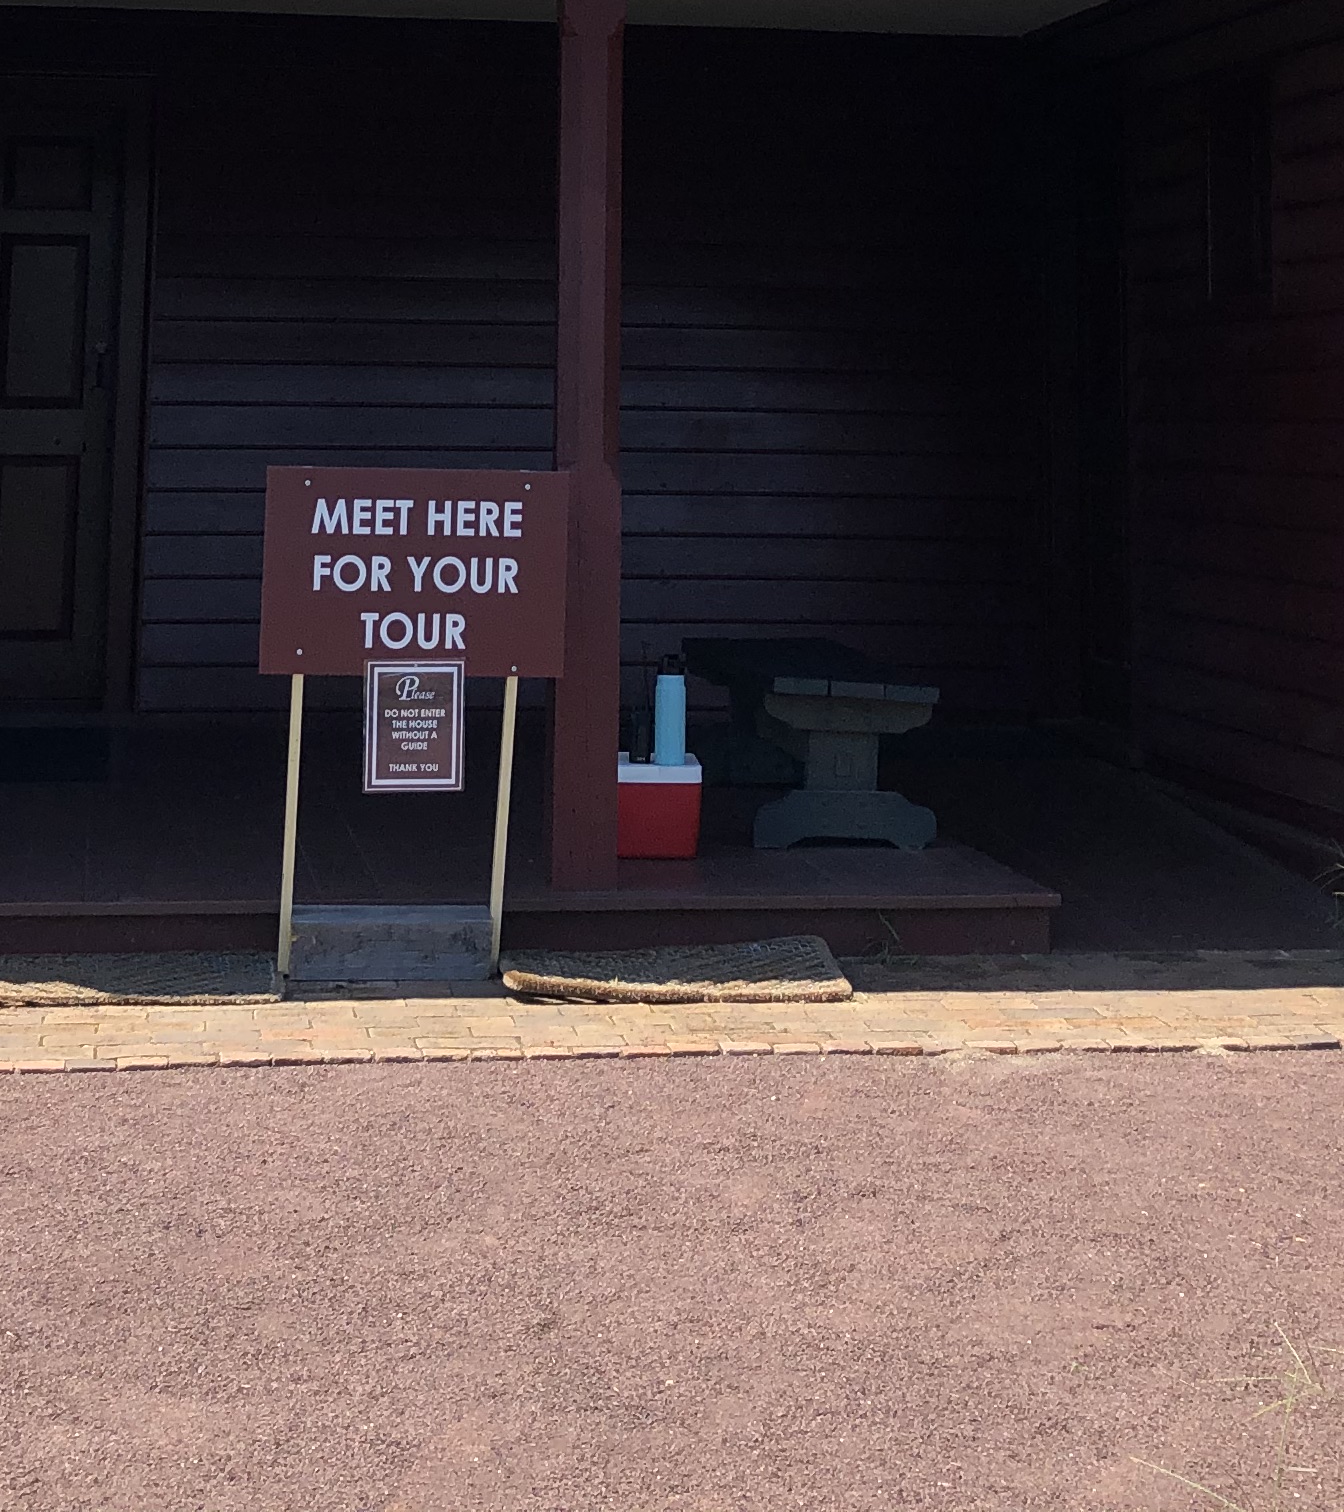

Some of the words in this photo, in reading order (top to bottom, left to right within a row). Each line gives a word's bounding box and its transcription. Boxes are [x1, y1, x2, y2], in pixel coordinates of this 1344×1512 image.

[311, 498, 414, 535] MEET
[427, 500, 523, 537] HERE
[312, 554, 392, 592] FOR
[407, 556, 519, 593] YOUR
[361, 612, 466, 650] TOUR
[396, 675, 435, 700] Please
[385, 709, 398, 717] DO
[401, 709, 419, 717] NOT
[421, 709, 446, 717] ENTER
[392, 720, 407, 728] THE
[409, 720, 438, 728] HOUSE
[392, 731, 428, 739] WITHOUT
[431, 731, 438, 739] A
[401, 742, 428, 750] GUIDE
[389, 764, 417, 772] THANK
[420, 764, 439, 772] YOU
